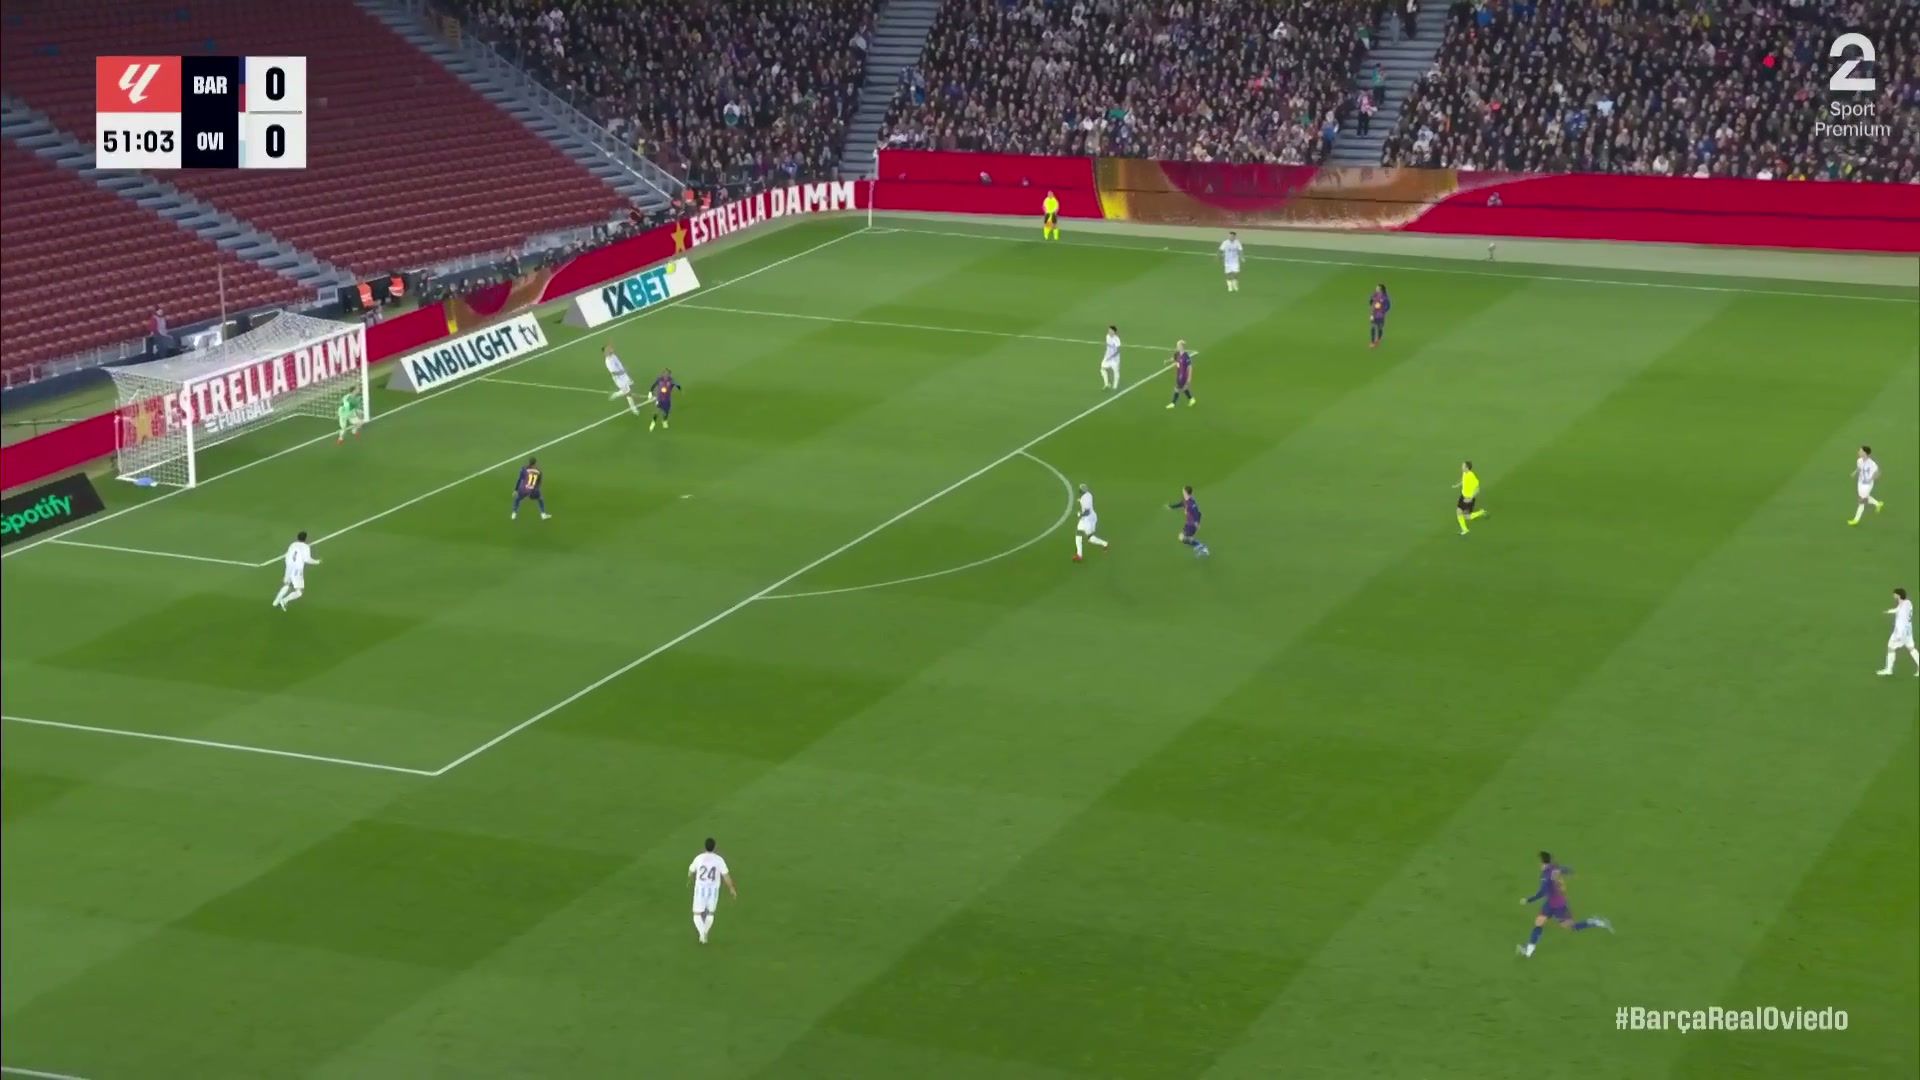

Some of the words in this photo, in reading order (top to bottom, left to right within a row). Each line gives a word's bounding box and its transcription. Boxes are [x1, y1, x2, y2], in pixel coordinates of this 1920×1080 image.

[689, 193, 767, 248] ESTRELLA
[770, 180, 856, 219] DAMM
[602, 266, 671, 318] 1XBET
[163, 356, 290, 434] ESTRELLA
[294, 330, 362, 389] DAMM
[411, 325, 518, 387] AMBILIGHT
[518, 323, 540, 346] tv
[699, 865, 717, 882] 24
